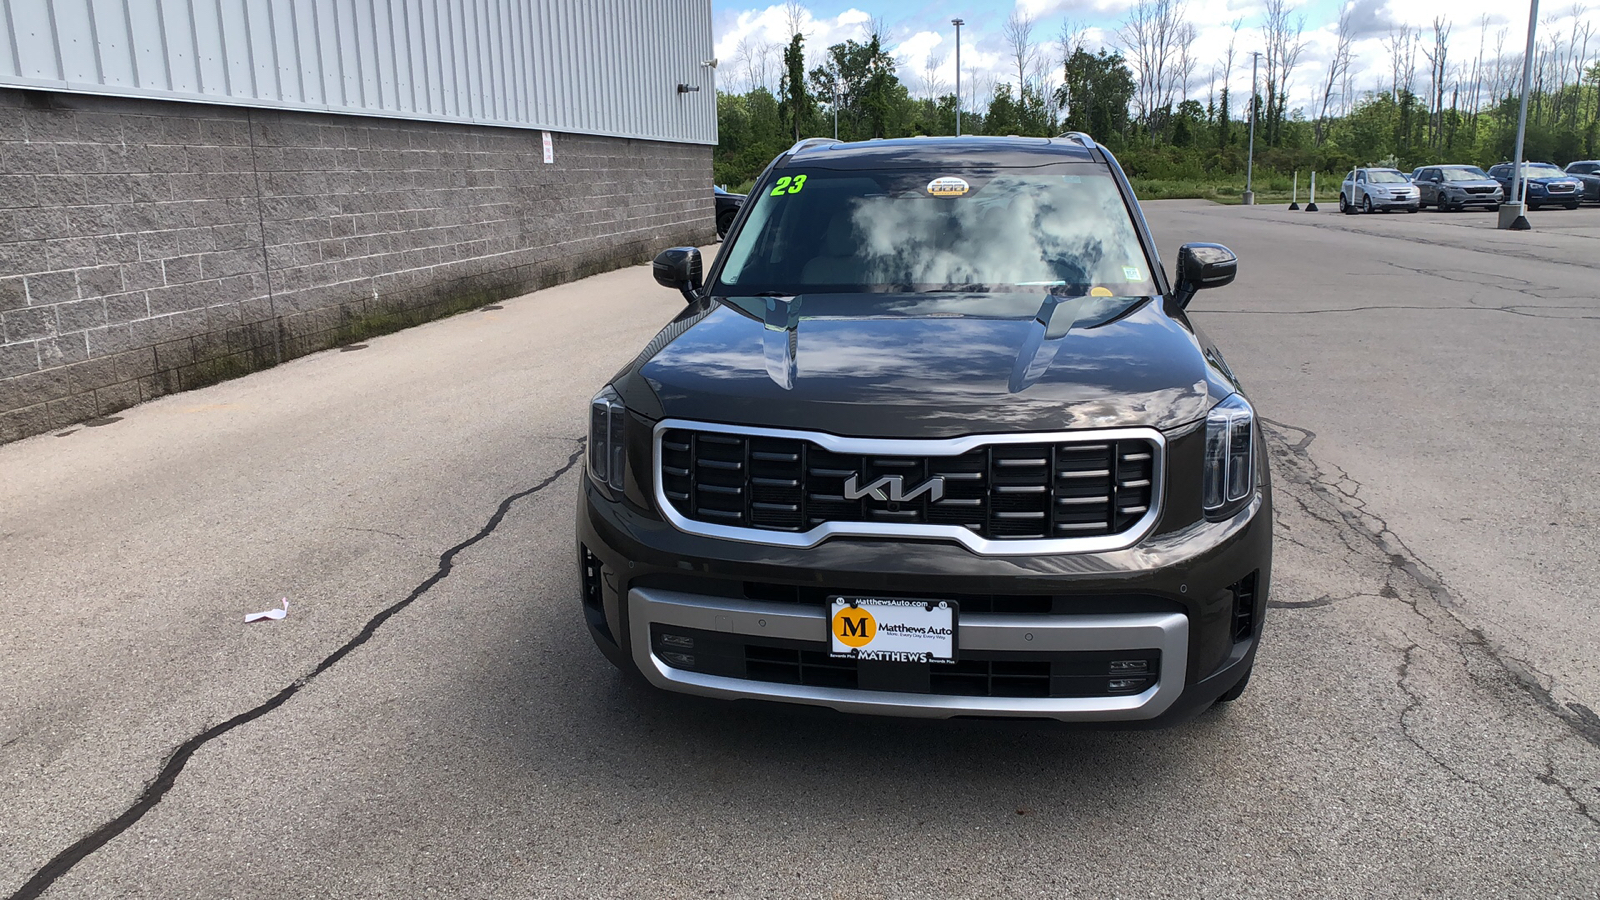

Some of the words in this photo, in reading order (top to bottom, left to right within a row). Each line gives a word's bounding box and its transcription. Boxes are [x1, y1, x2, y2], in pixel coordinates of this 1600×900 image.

[770, 174, 807, 197] 23
[844, 472, 945, 502] KIA
[855, 598, 928, 607] MatthewsAuto.com
[840, 616, 869, 637] M
[878, 622, 926, 634] Matthews
[927, 625, 953, 635] Auto
[857, 650, 927, 663] MATTHEWS
